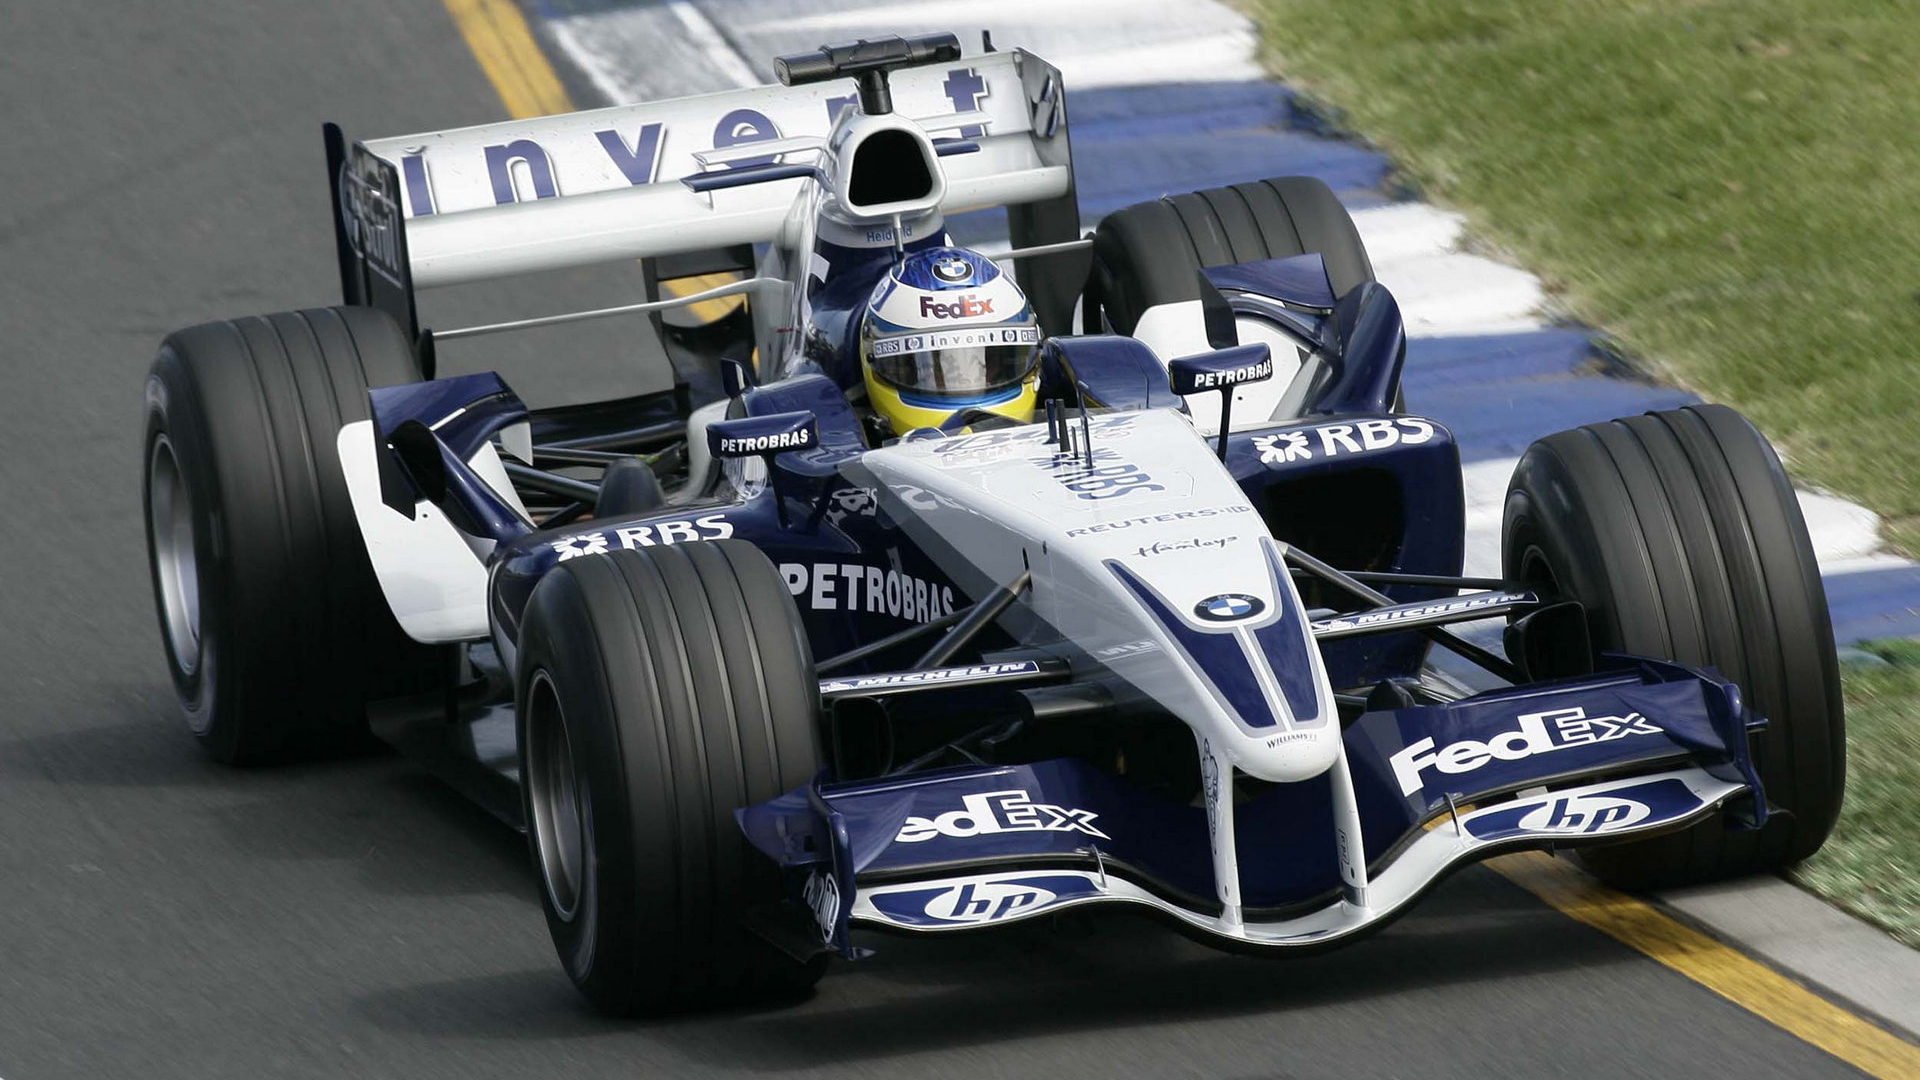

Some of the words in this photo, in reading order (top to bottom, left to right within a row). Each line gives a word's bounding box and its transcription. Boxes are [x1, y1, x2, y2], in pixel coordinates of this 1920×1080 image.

[402, 67, 990, 217] invet
[920, 294, 994, 319] FedEx
[1194, 359, 1271, 388] PETROBRAS
[721, 428, 809, 452] PETROBRAS
[1316, 418, 1434, 456] RBS
[615, 514, 735, 550] RBS
[779, 563, 953, 624] PETROBRAS
[1358, 593, 1524, 625] MICHELIN
[857, 662, 1026, 687] MICHELIN
[1389, 706, 1664, 798] FedEx
[895, 790, 1112, 843] edEx
[1554, 796, 1631, 832] hp
[953, 884, 1039, 921] hp
